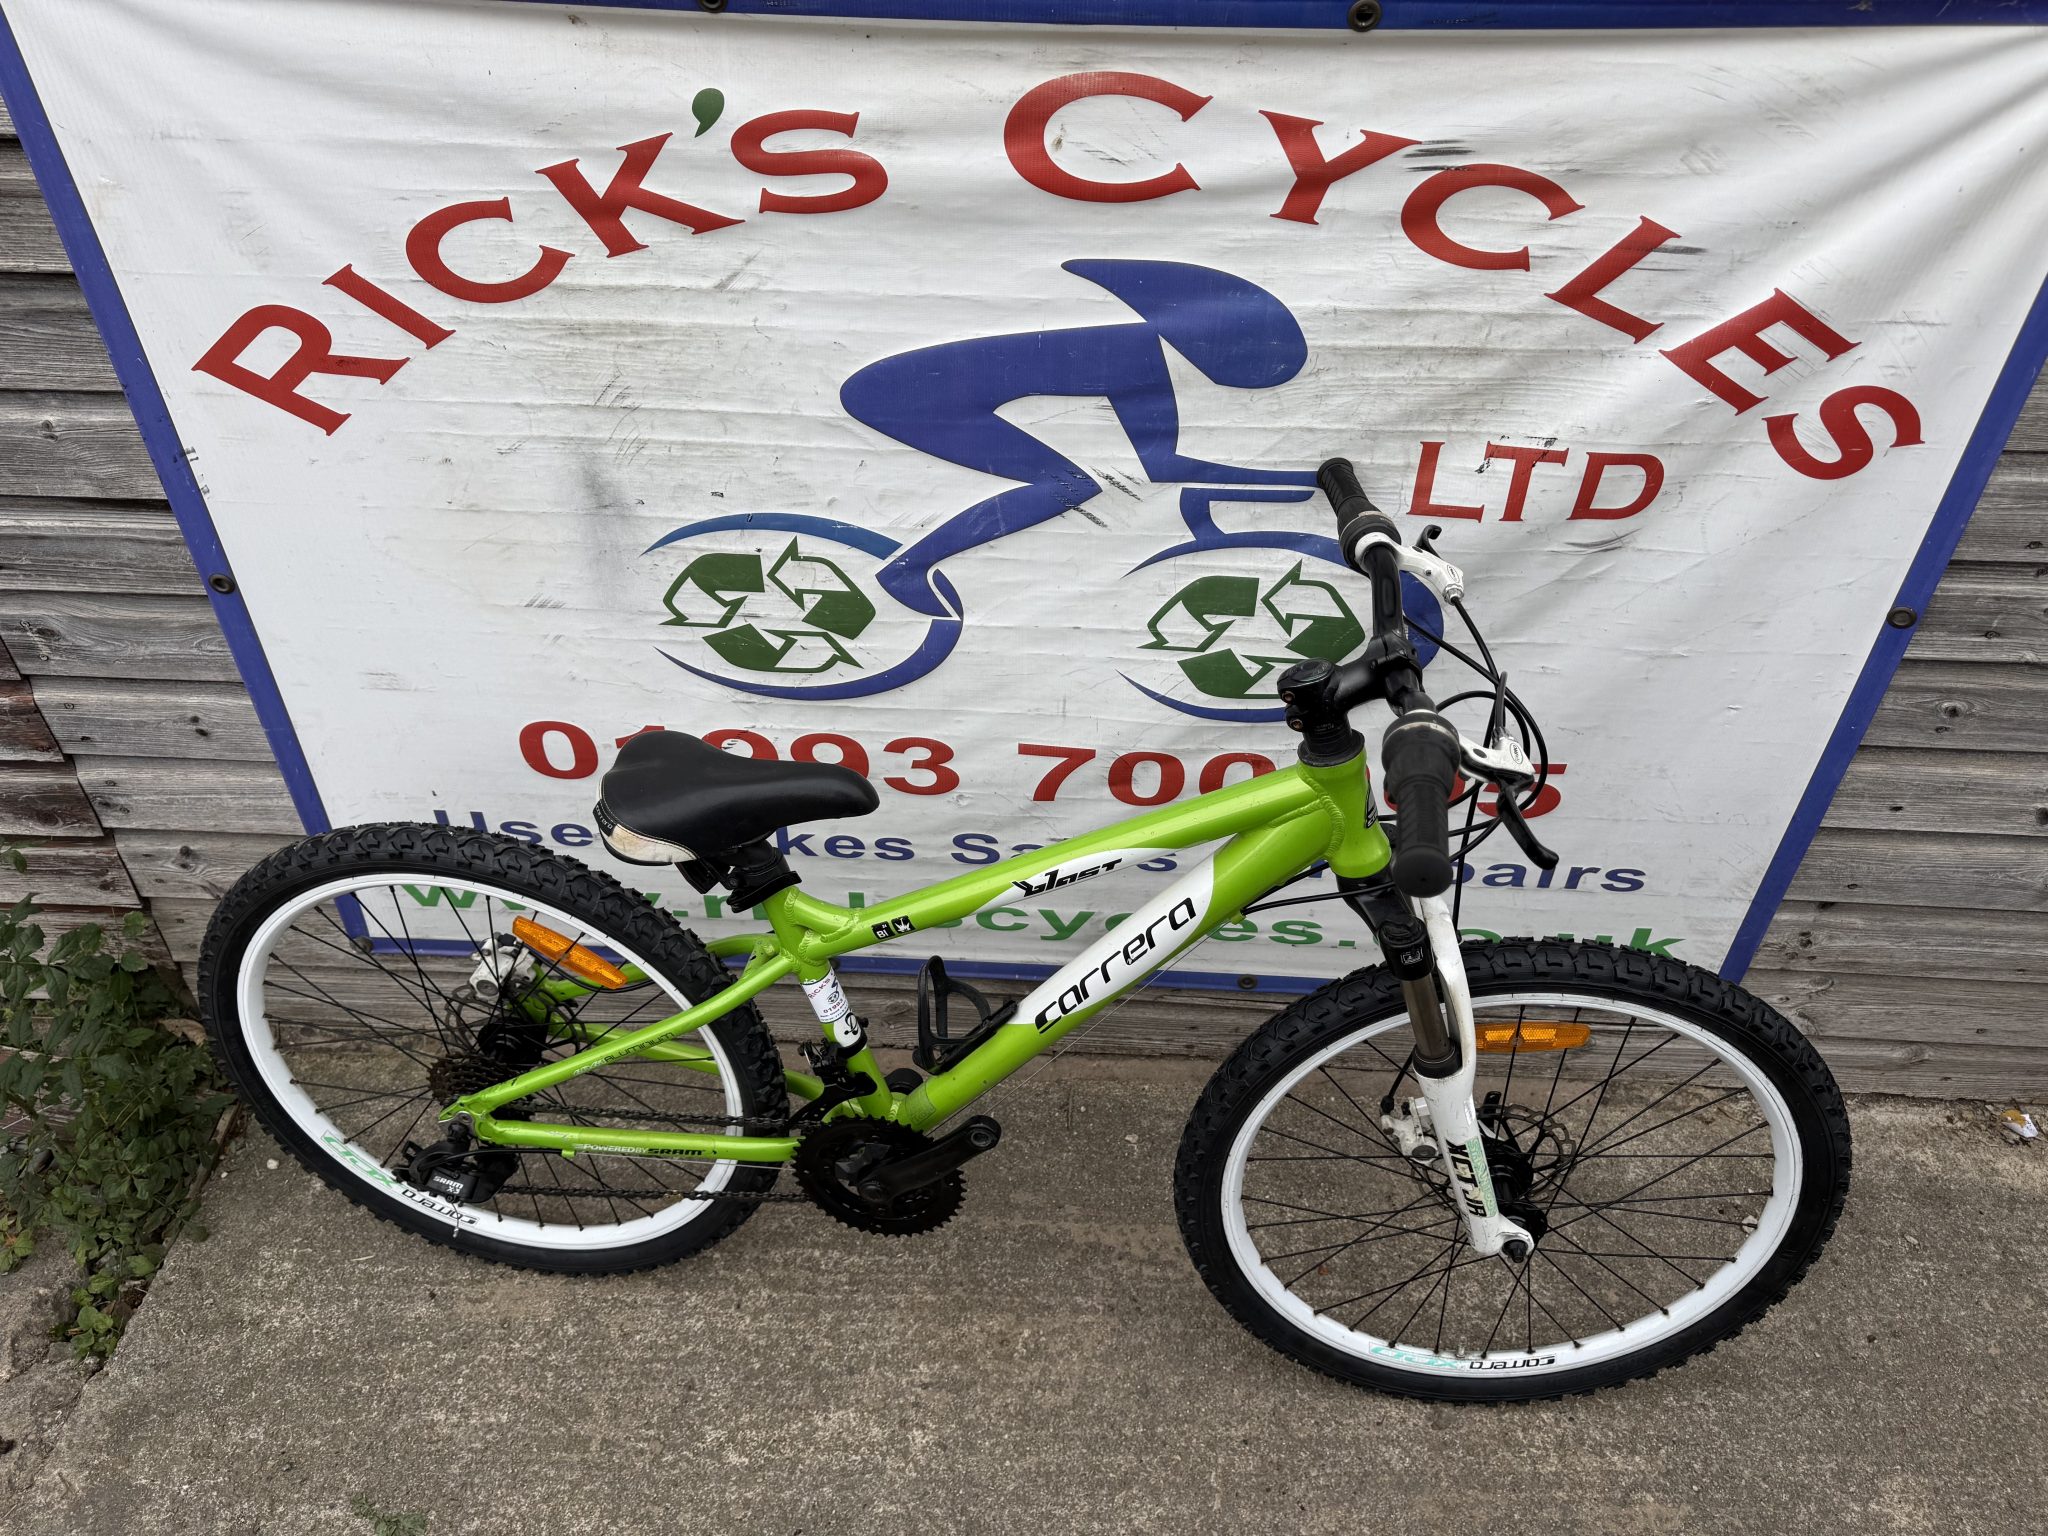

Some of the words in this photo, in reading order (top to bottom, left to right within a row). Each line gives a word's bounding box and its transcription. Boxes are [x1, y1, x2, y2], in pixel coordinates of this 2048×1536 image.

[191, 88, 889, 437] RICK'S
[1003, 71, 1927, 481] CYCLES
[1405, 440, 1668, 523] LTD
[775, 826, 916, 861] kes
[1034, 897, 1198, 1035] carrera
[433, 1175, 464, 1190] SRAM
[1469, 1356, 1556, 1370] carrera
